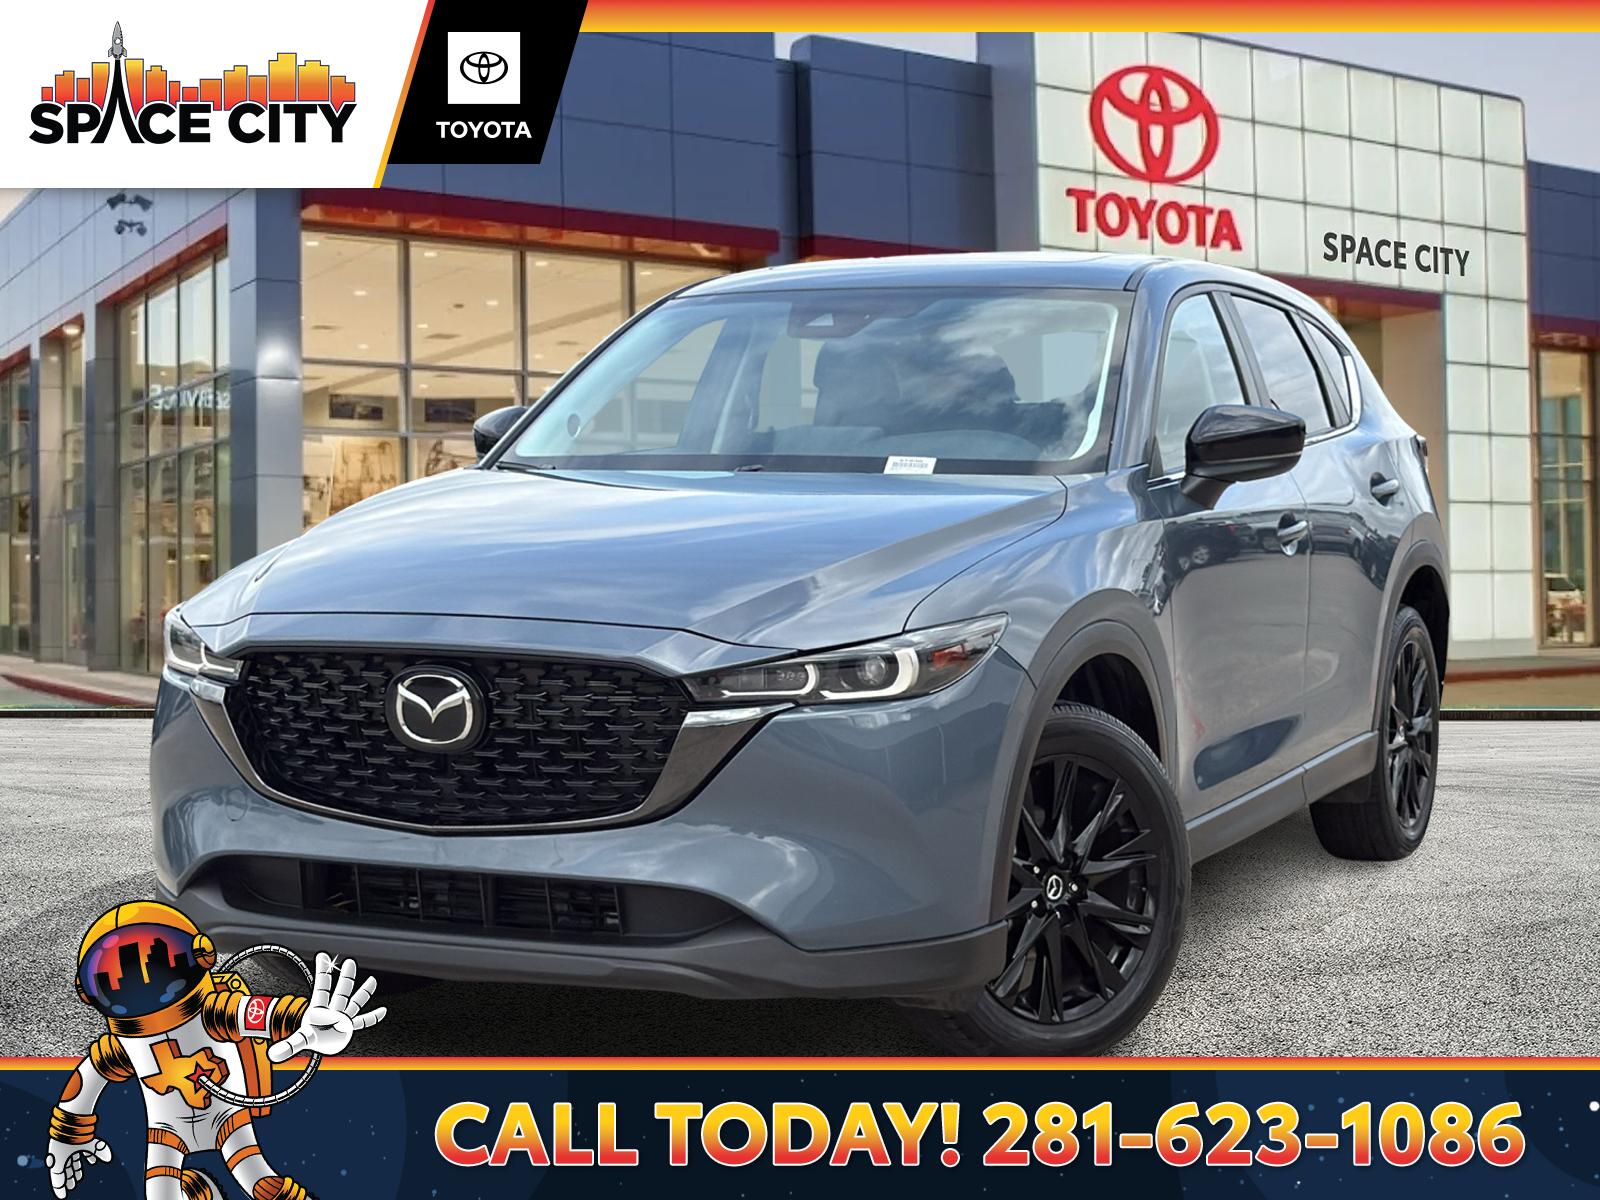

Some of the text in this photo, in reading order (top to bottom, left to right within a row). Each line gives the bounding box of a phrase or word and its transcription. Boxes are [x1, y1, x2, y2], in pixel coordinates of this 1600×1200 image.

[1066, 188, 1243, 251] TOYOTA
[1323, 231, 1470, 277] SPACE CITY
